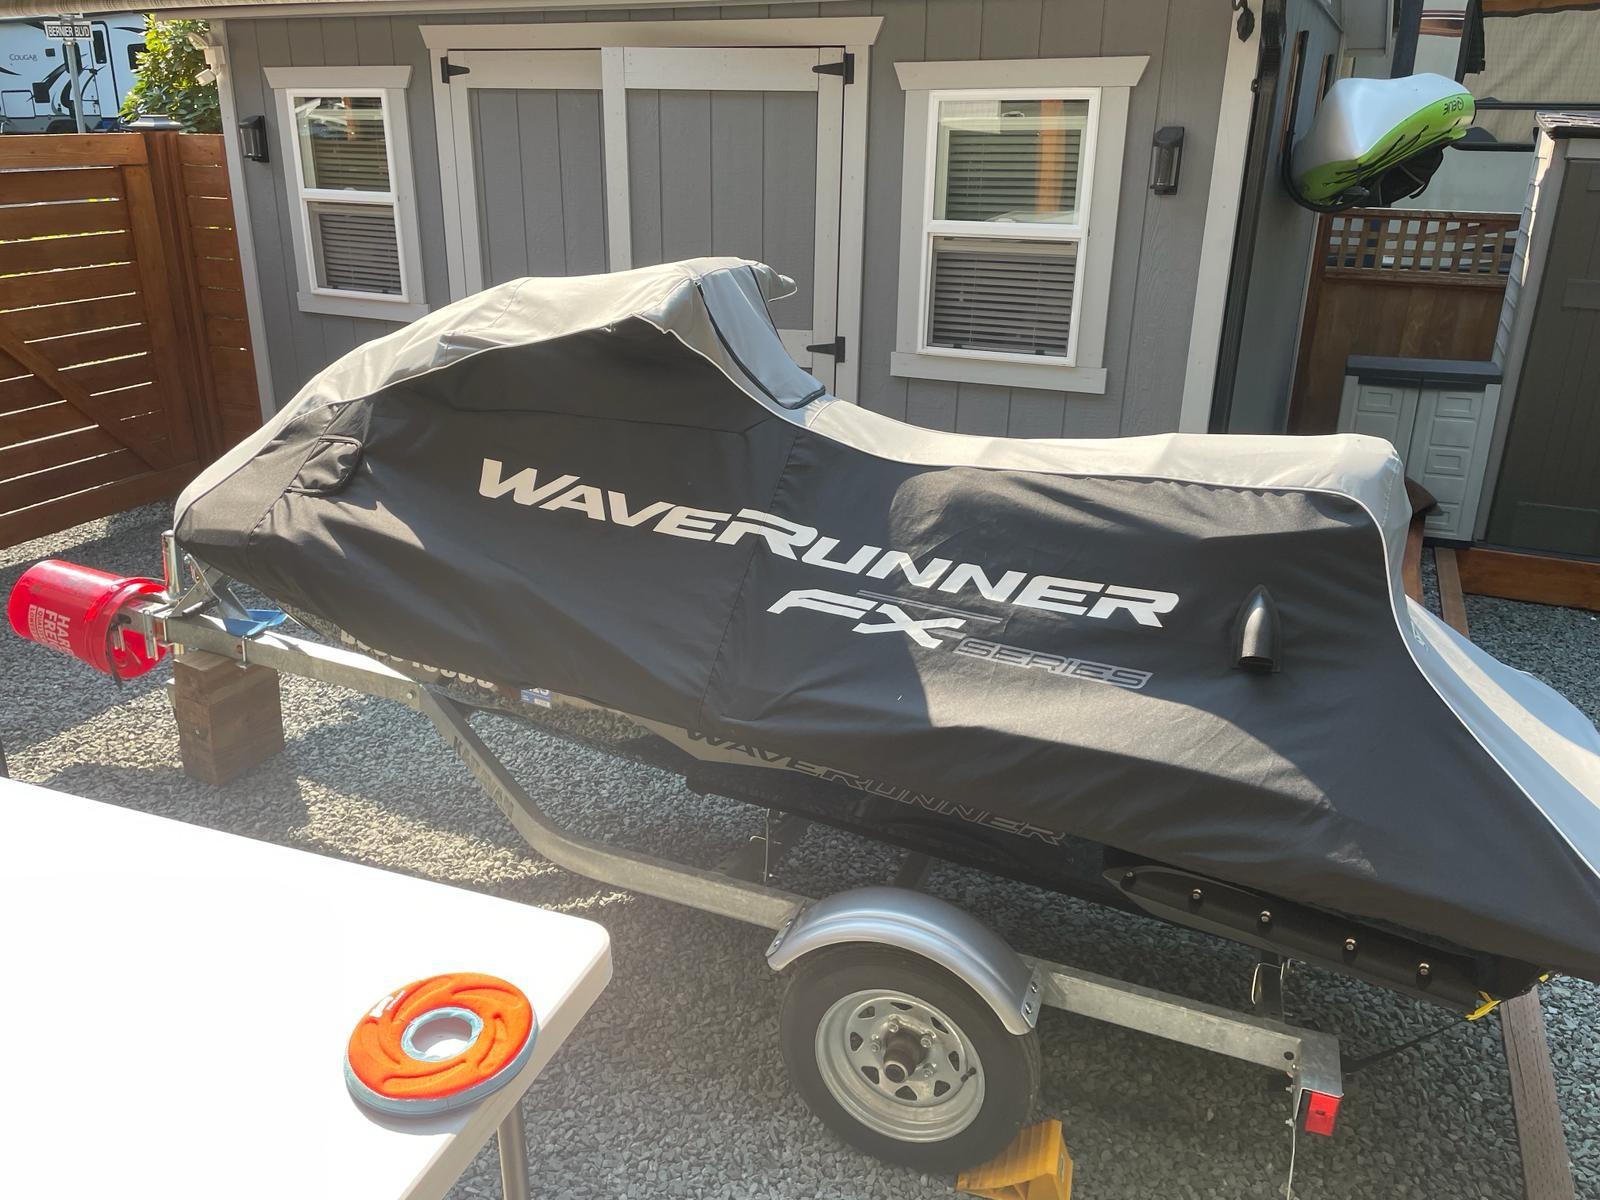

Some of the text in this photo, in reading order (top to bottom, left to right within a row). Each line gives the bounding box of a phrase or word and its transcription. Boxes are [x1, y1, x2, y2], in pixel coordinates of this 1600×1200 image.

[48, 26, 90, 37] BERNIER BLVD
[9, 53, 37, 62] COUGAR
[479, 458, 1180, 628] WAVERUNNER
[57, 614, 74, 655] HARB
[767, 588, 1153, 690] FX SERIES
